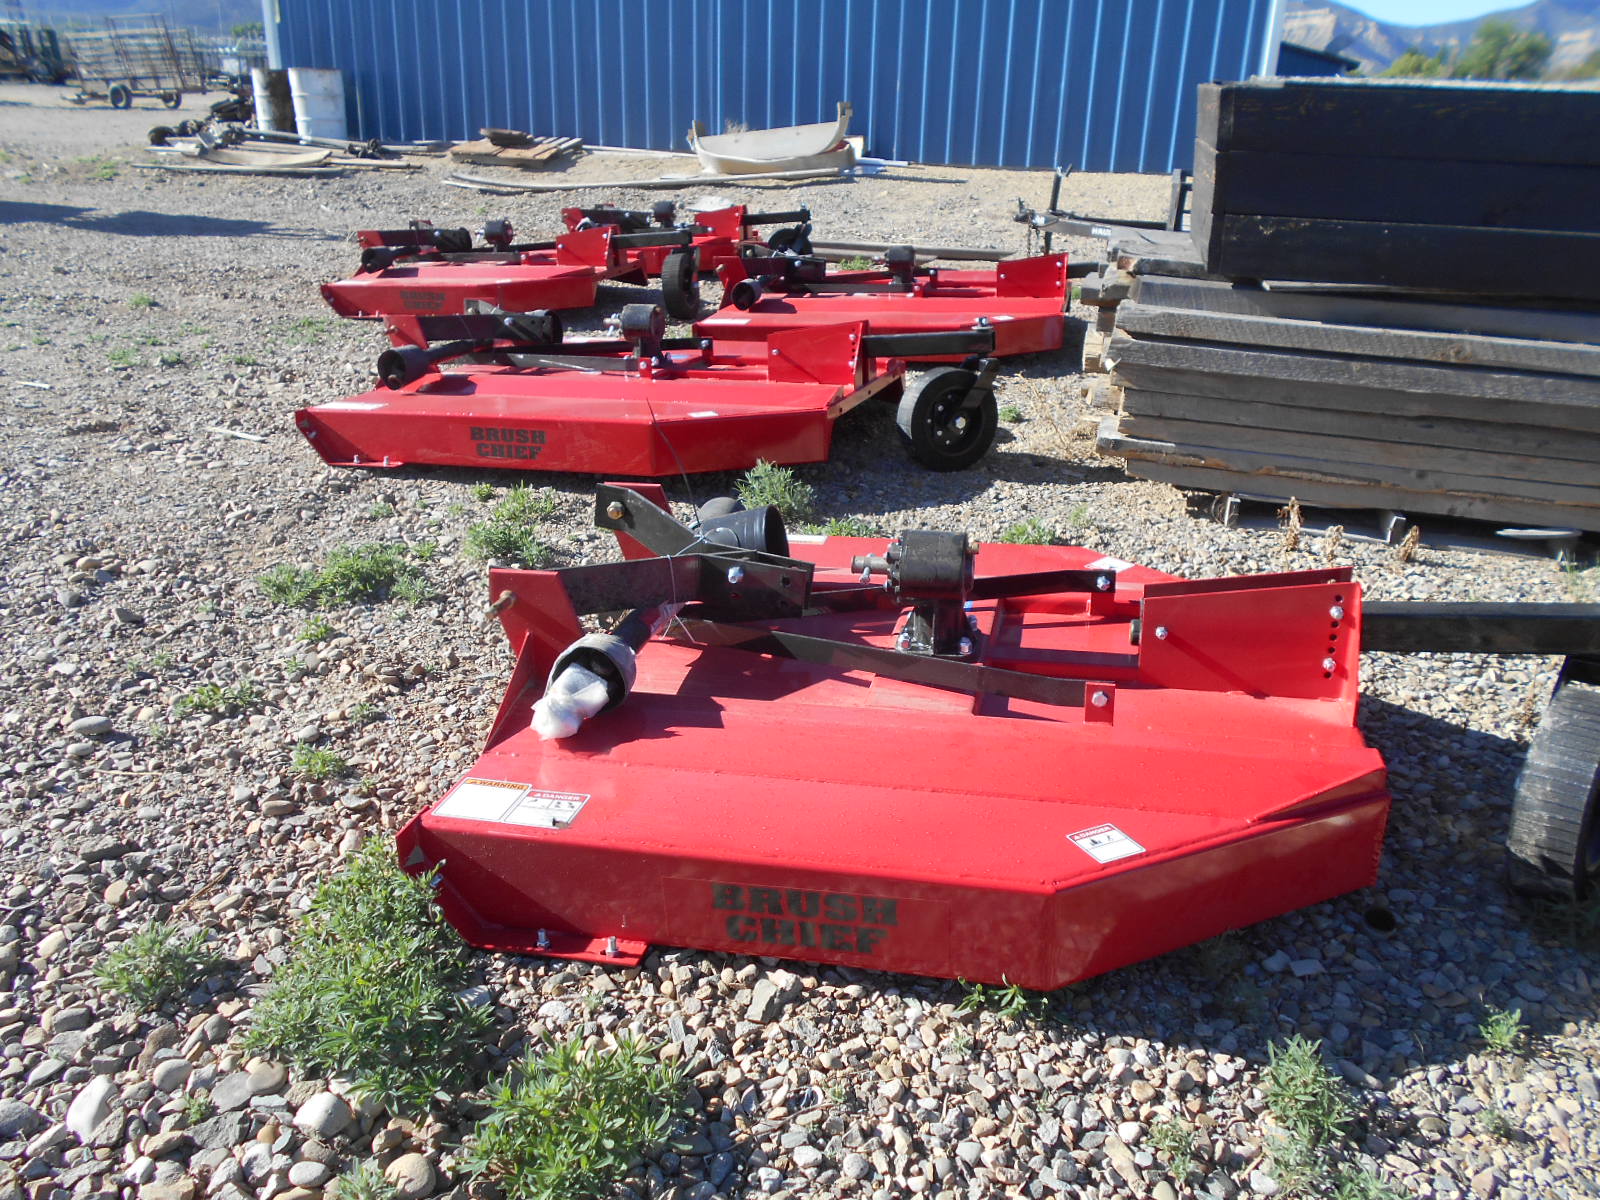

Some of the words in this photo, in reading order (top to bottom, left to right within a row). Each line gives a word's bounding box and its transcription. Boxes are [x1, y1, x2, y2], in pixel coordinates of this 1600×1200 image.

[470, 426, 547, 444] BRUSH
[477, 443, 542, 460] CHIEF
[479, 780, 526, 790] WARNING
[542, 793, 580, 801] DANGER
[712, 883, 898, 926] BRUSH
[726, 915, 888, 953] CHIEF
